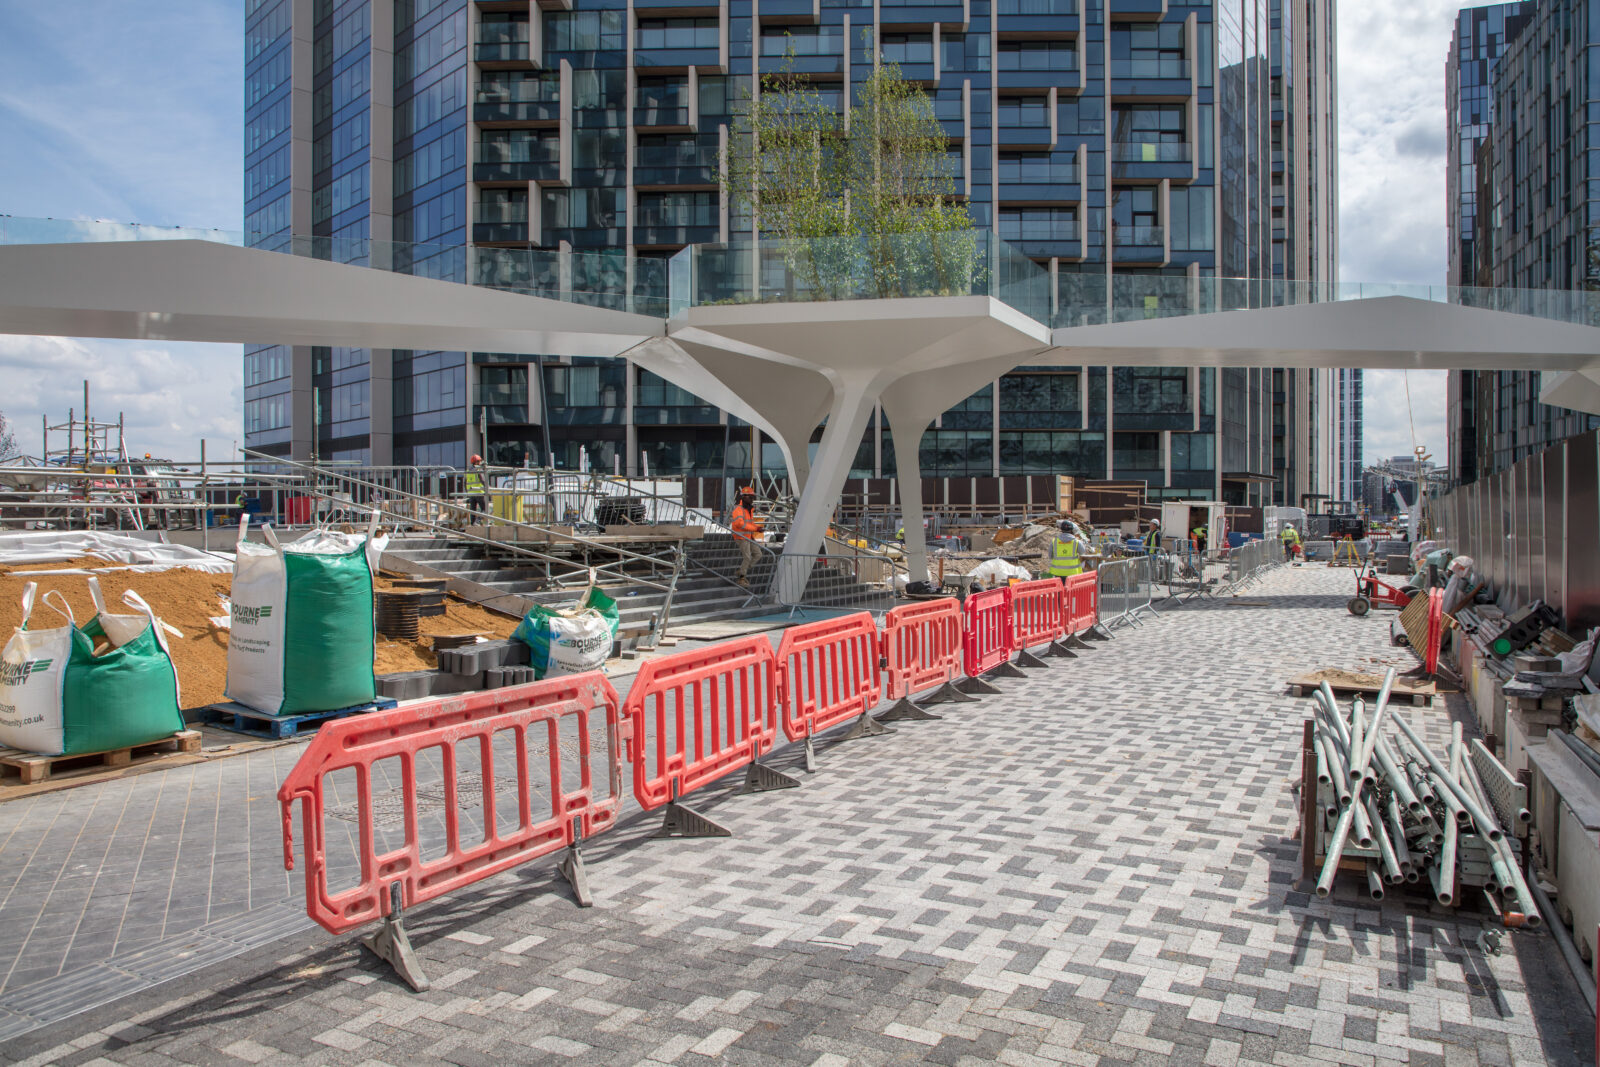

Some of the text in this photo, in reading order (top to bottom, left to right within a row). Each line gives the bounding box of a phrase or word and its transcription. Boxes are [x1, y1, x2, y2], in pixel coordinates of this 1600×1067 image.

[234, 615, 258, 625] AMENITY
[0, 659, 34, 677] OURNE
[0, 674, 29, 686] MENITY
